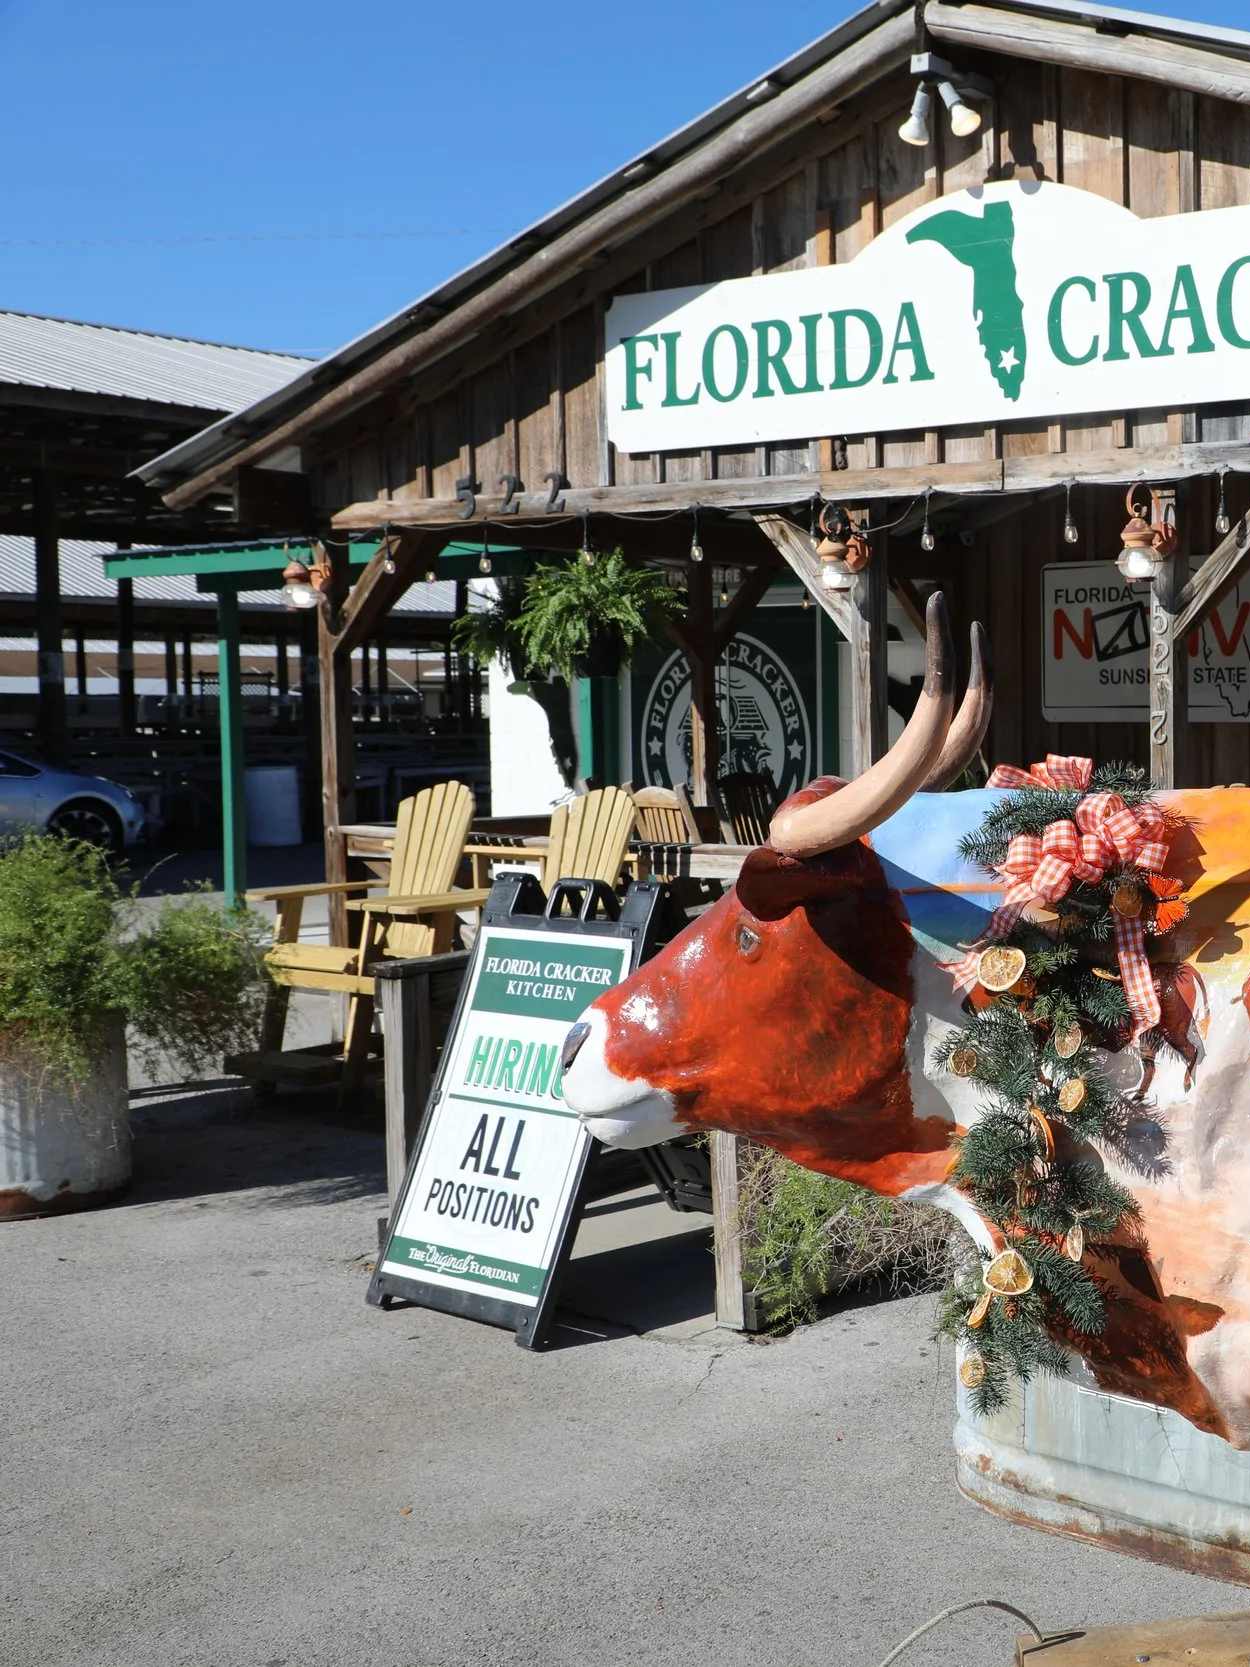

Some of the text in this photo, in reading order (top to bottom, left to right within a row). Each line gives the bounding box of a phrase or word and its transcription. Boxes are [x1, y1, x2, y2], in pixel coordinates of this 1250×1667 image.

[620, 301, 935, 411] FLORIDA
[455, 472, 566, 520] 522
[1054, 586, 1134, 604] FLORIDA
[720, 642, 800, 735] CRACKER
[1193, 667, 1248, 683] STATE
[485, 956, 612, 986] FLORIDA CRACKER
[505, 980, 577, 1001] KITCHEN
[459, 1113, 526, 1181] ALL
[423, 1177, 540, 1234] POSITIONS
[408, 1247, 427, 1262] THE
[468, 1260, 521, 1284] FLORIDIAN
